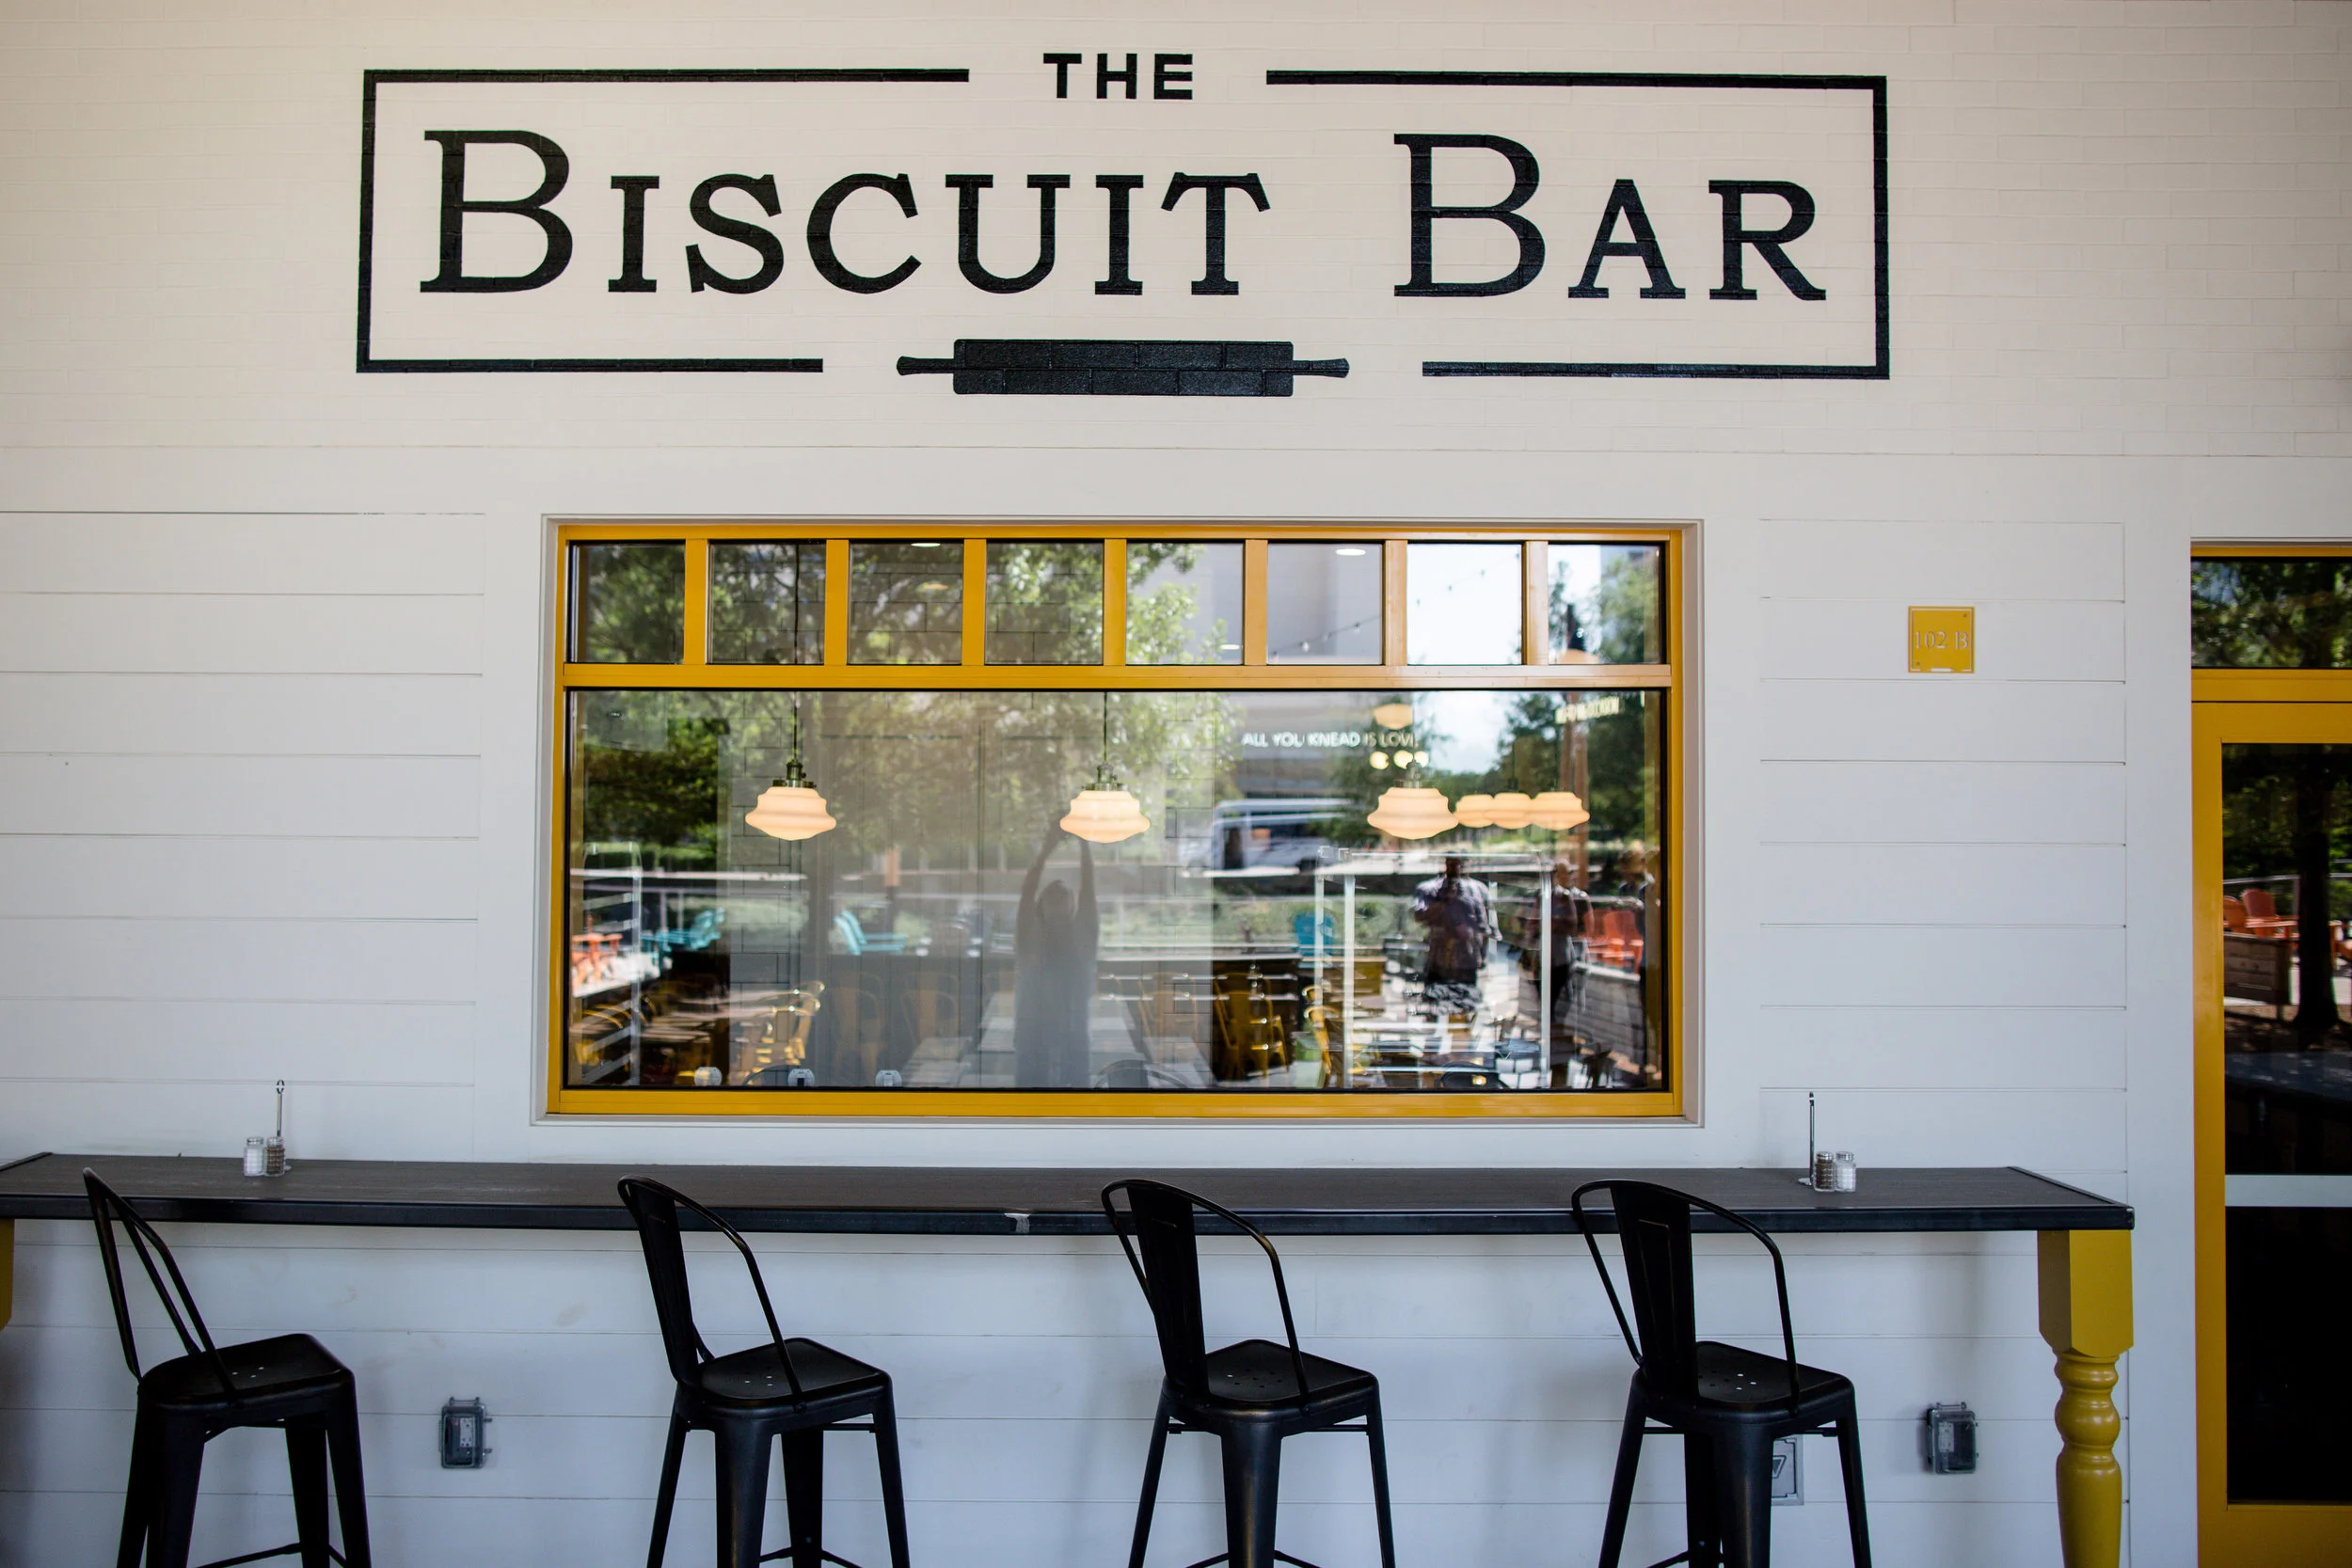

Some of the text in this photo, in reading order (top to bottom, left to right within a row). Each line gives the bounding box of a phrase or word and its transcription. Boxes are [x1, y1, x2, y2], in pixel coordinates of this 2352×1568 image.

[1043, 54, 1193, 100] THE
[421, 131, 1827, 300] BISCUIT BAR
[1915, 631, 1969, 649] 102 B
[1242, 732, 1268, 748] ALL
[1272, 732, 1305, 748] YOU
[1307, 732, 1361, 748] KNEAD
[1364, 732, 1377, 747] IS
